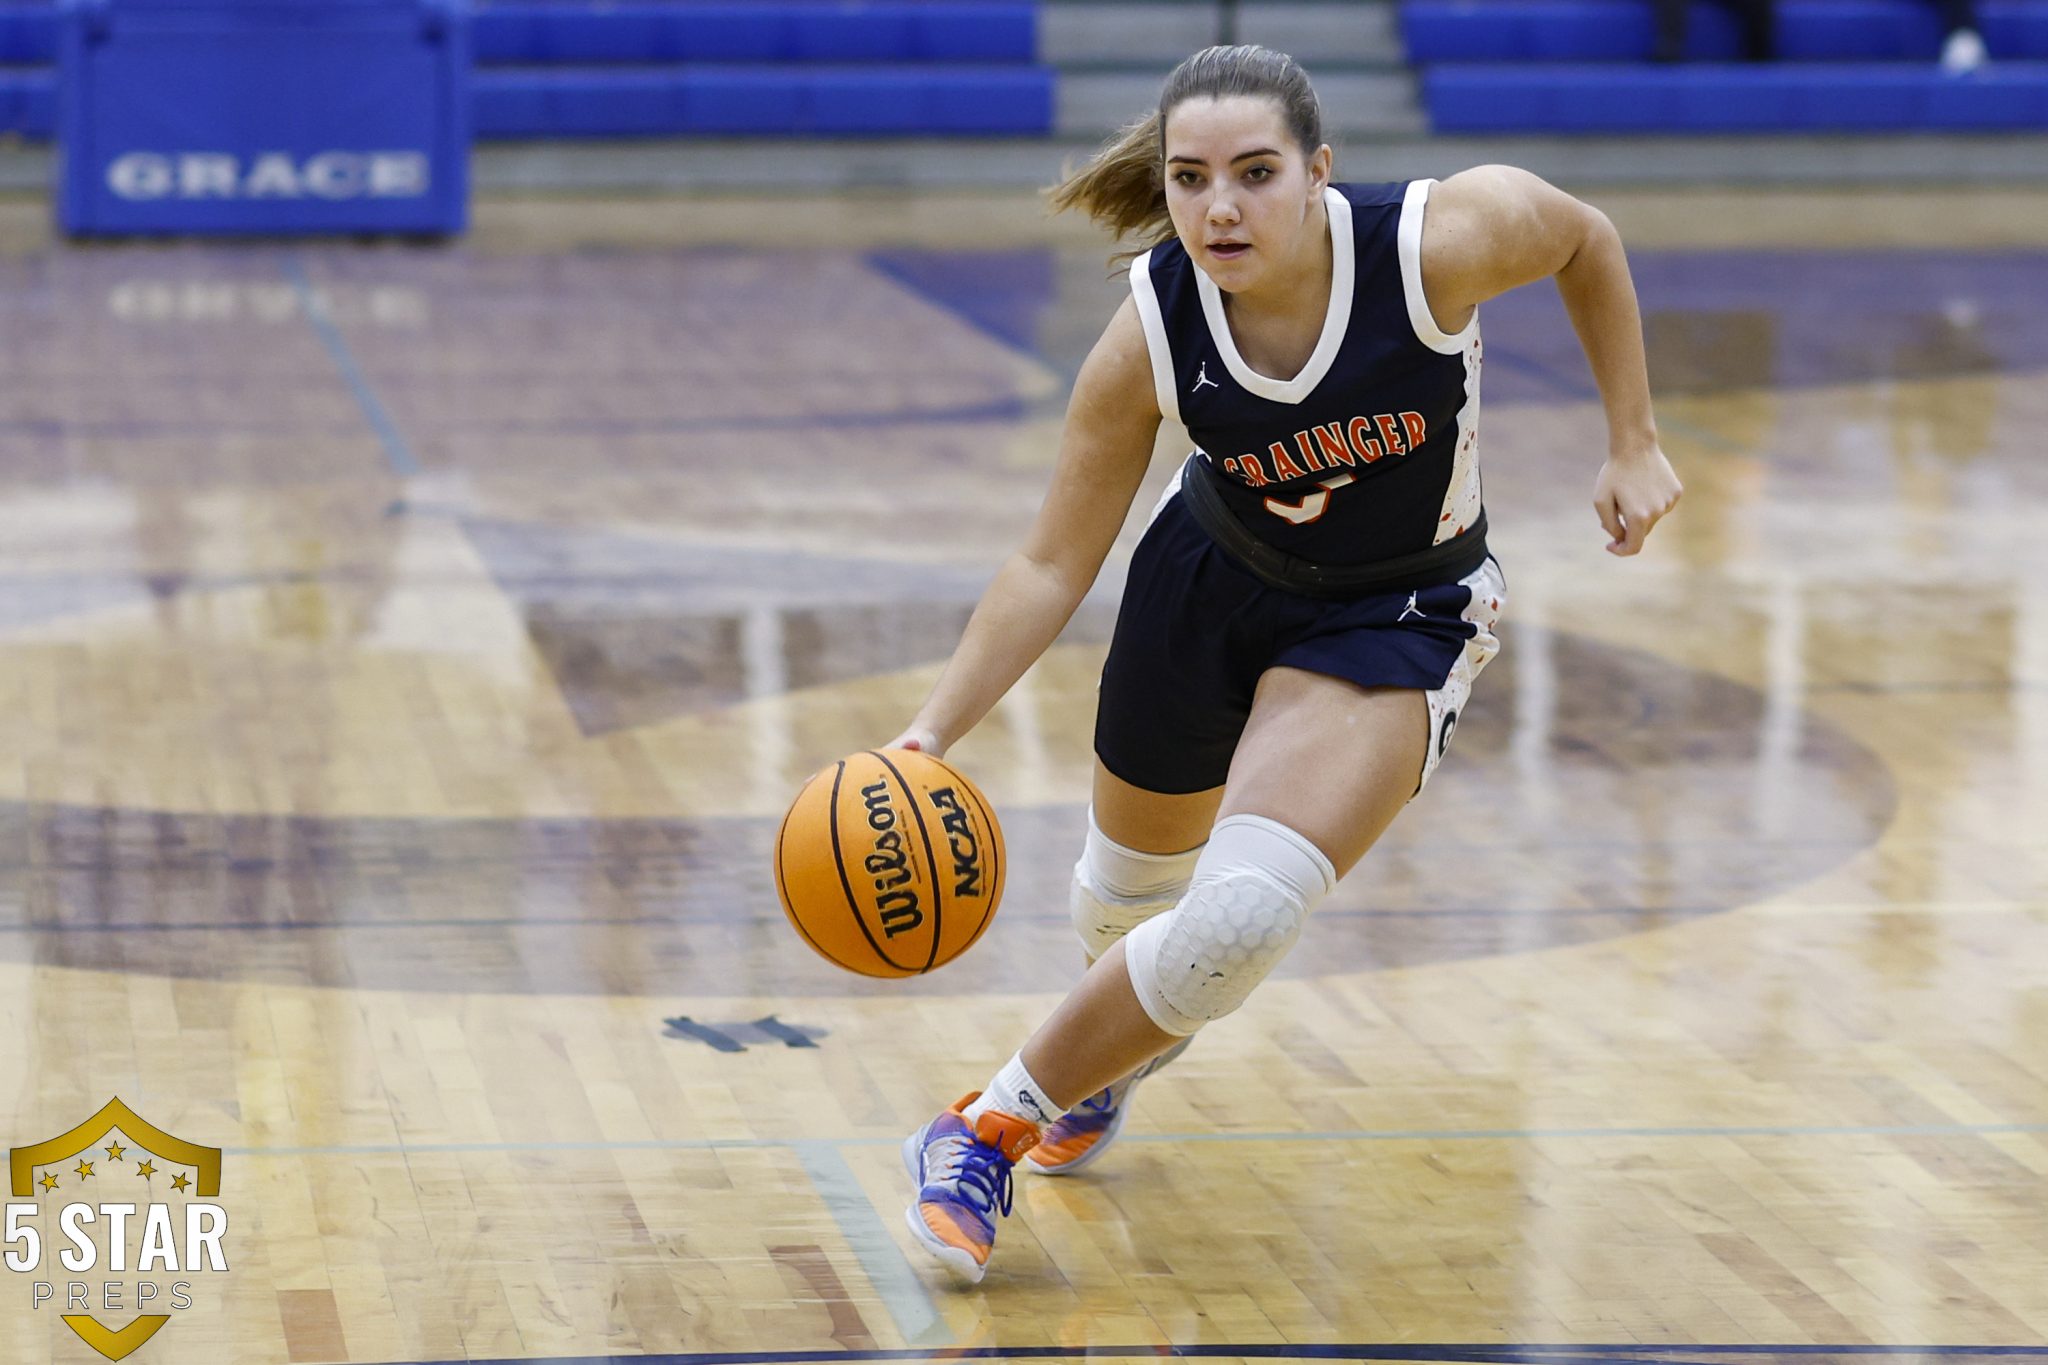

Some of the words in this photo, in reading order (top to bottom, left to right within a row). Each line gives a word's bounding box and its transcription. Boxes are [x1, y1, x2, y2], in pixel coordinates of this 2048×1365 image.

[107, 150, 430, 200] GRACE
[1223, 411, 1427, 488] GRAINGER
[860, 780, 924, 939] Wilson
[929, 785, 980, 898] NCAA
